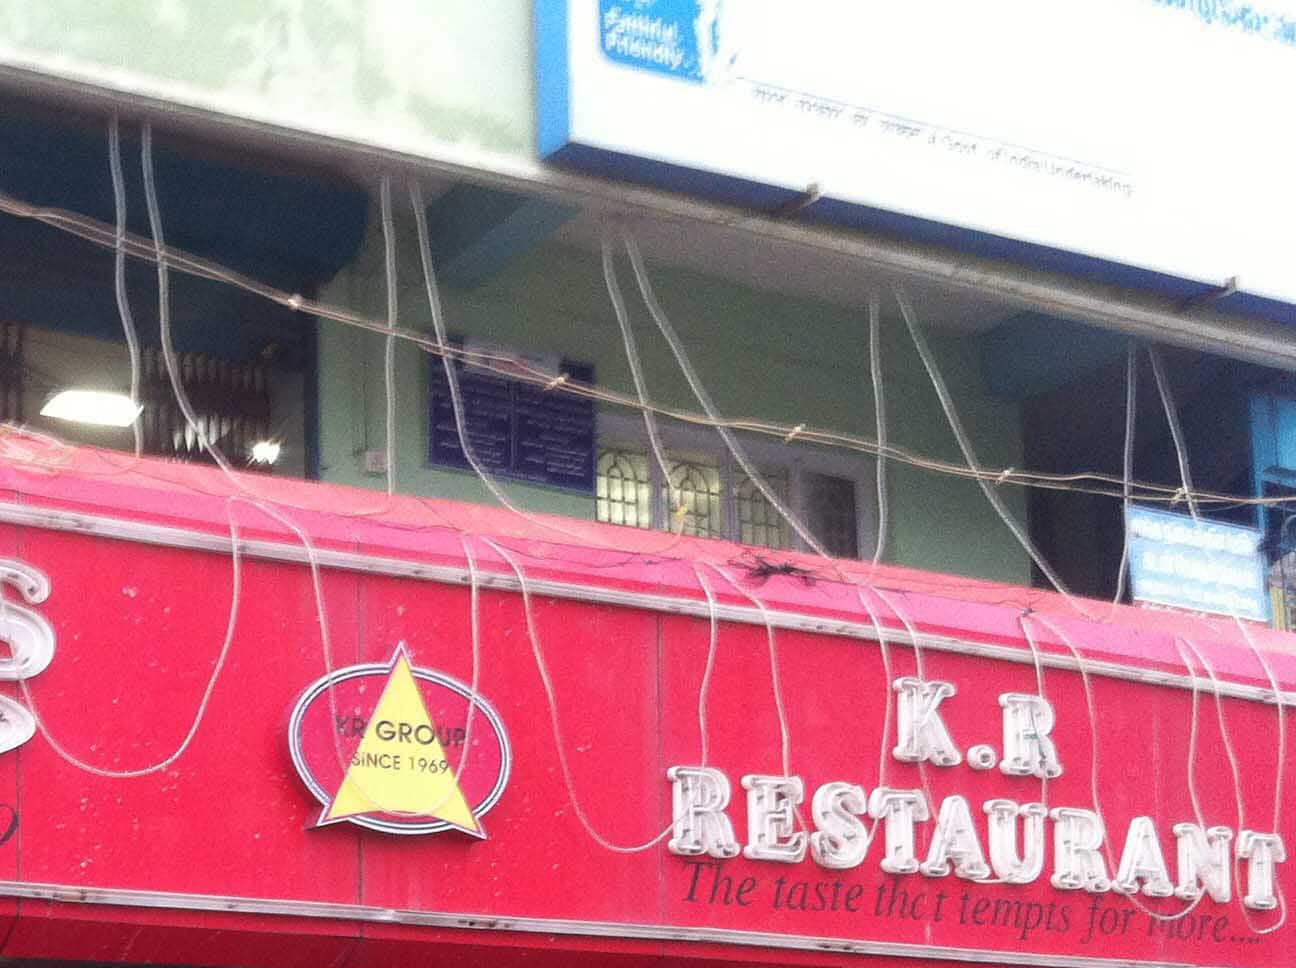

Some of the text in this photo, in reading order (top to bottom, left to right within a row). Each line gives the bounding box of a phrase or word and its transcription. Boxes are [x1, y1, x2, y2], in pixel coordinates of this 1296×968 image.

[374, 719, 467, 748] GROUP
[408, 757, 450, 775] 1969
[893, 676, 1064, 779] K.R
[666, 765, 1286, 911] RESTAURANT
[682, 860, 757, 907] The
[771, 874, 864, 913] taste
[959, 890, 1071, 940] tempts
[1080, 896, 1136, 944] for
